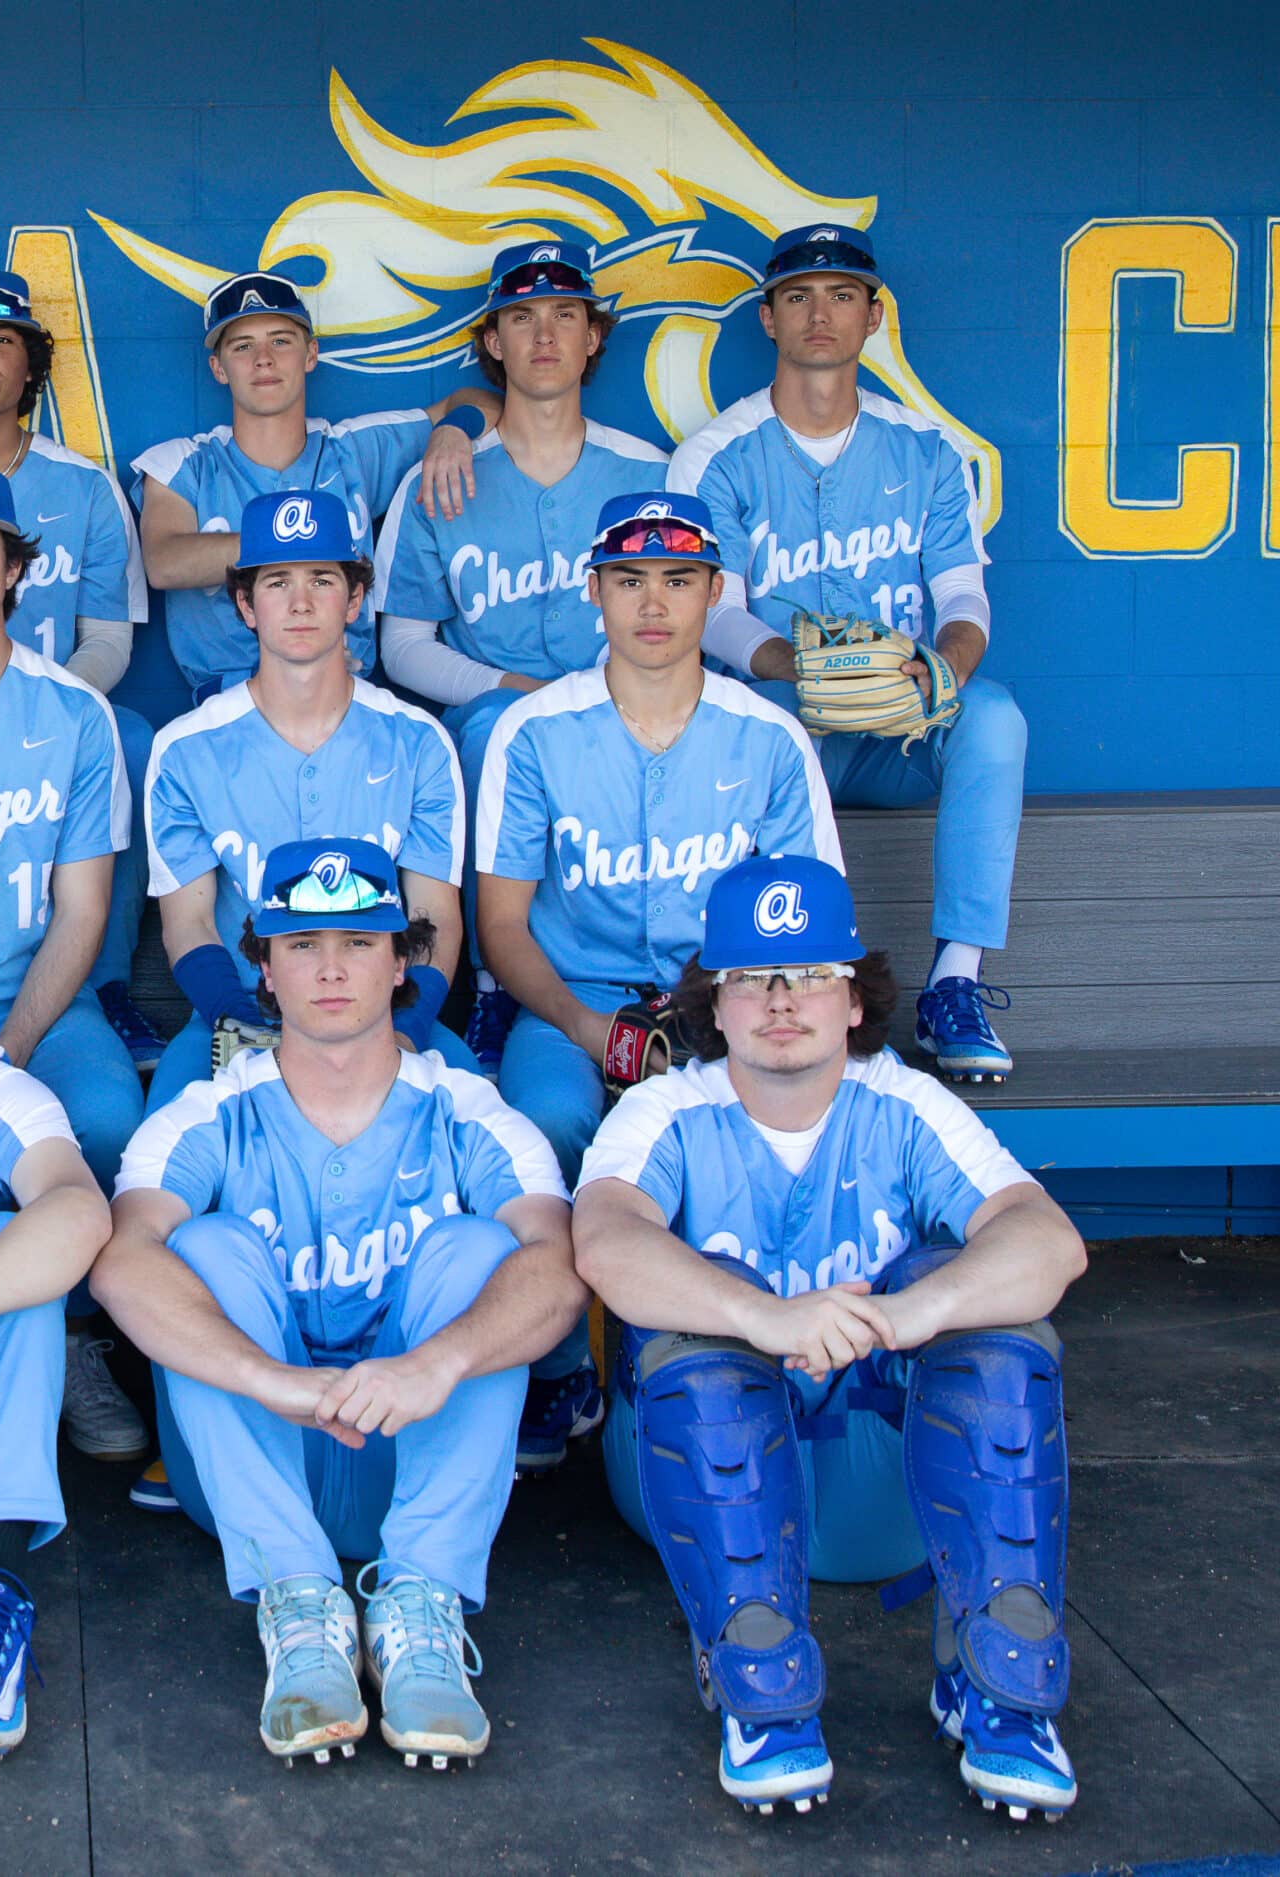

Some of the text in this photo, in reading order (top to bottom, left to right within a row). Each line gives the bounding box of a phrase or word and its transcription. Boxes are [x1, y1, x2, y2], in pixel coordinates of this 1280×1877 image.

[1057, 216, 1280, 560] C
[272, 497, 318, 542] a
[748, 511, 928, 599] Charger
[871, 584, 924, 641] 13
[824, 655, 871, 669] A2000
[554, 815, 761, 893] Charger
[753, 880, 809, 938] a
